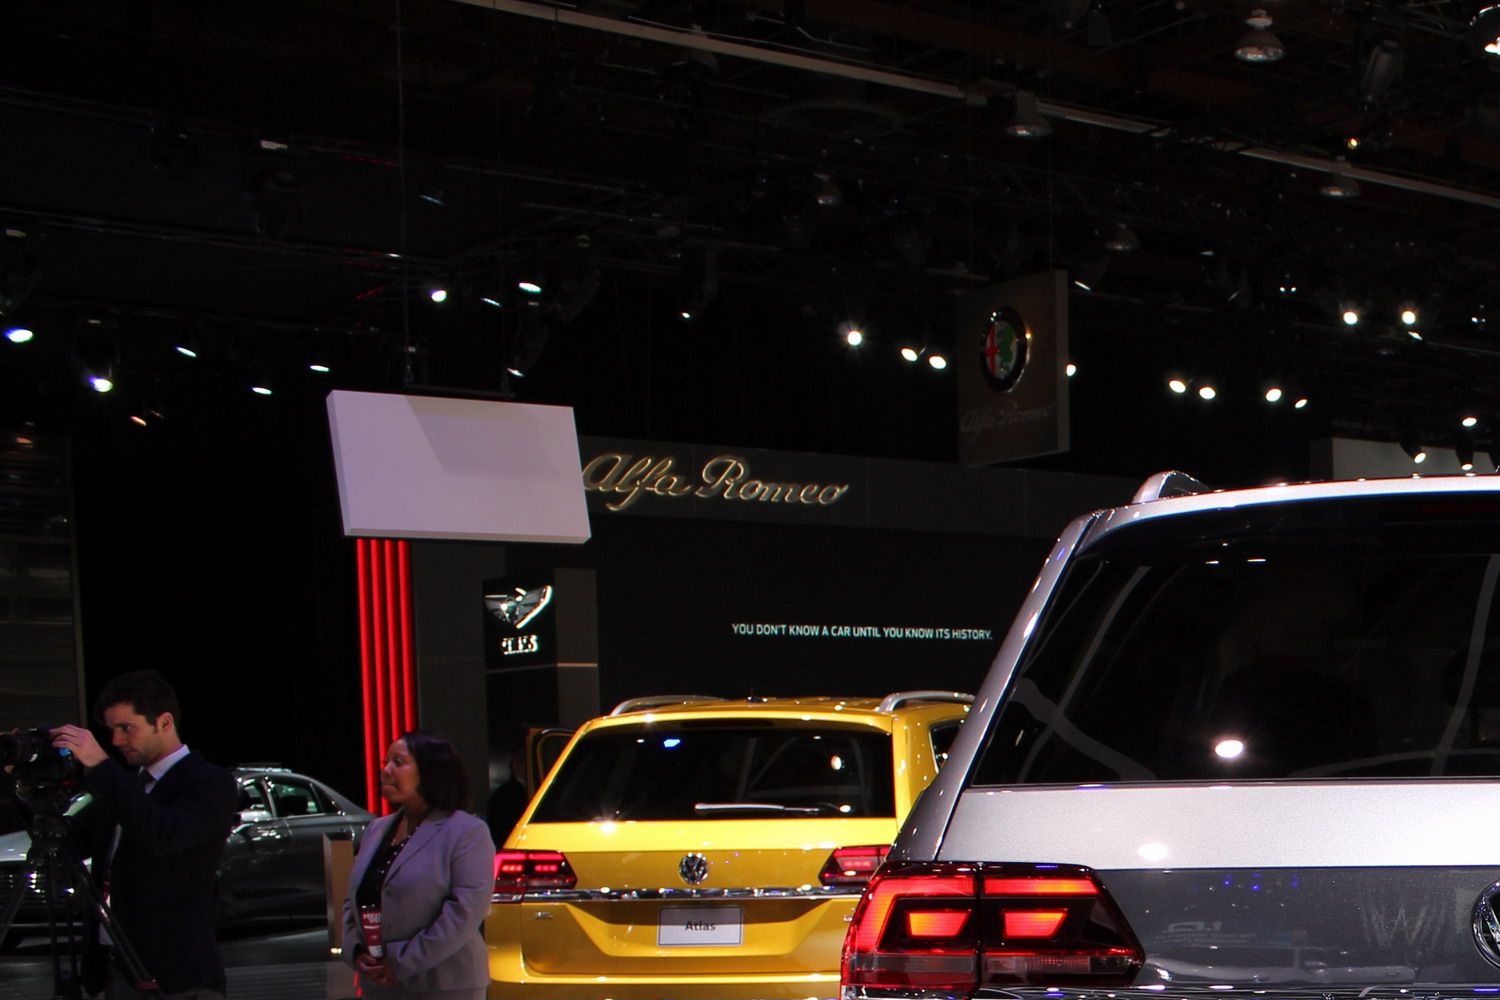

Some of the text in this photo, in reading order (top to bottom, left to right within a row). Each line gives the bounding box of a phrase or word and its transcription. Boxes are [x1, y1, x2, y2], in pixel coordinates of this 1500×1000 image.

[583, 453, 849, 511] Alfa Romeo
[731, 623, 993, 640] YOU DON'T KNOW A CAR UNTIL YOU KNOW ITS HISTORY.
[685, 920, 716, 931] Atlas
